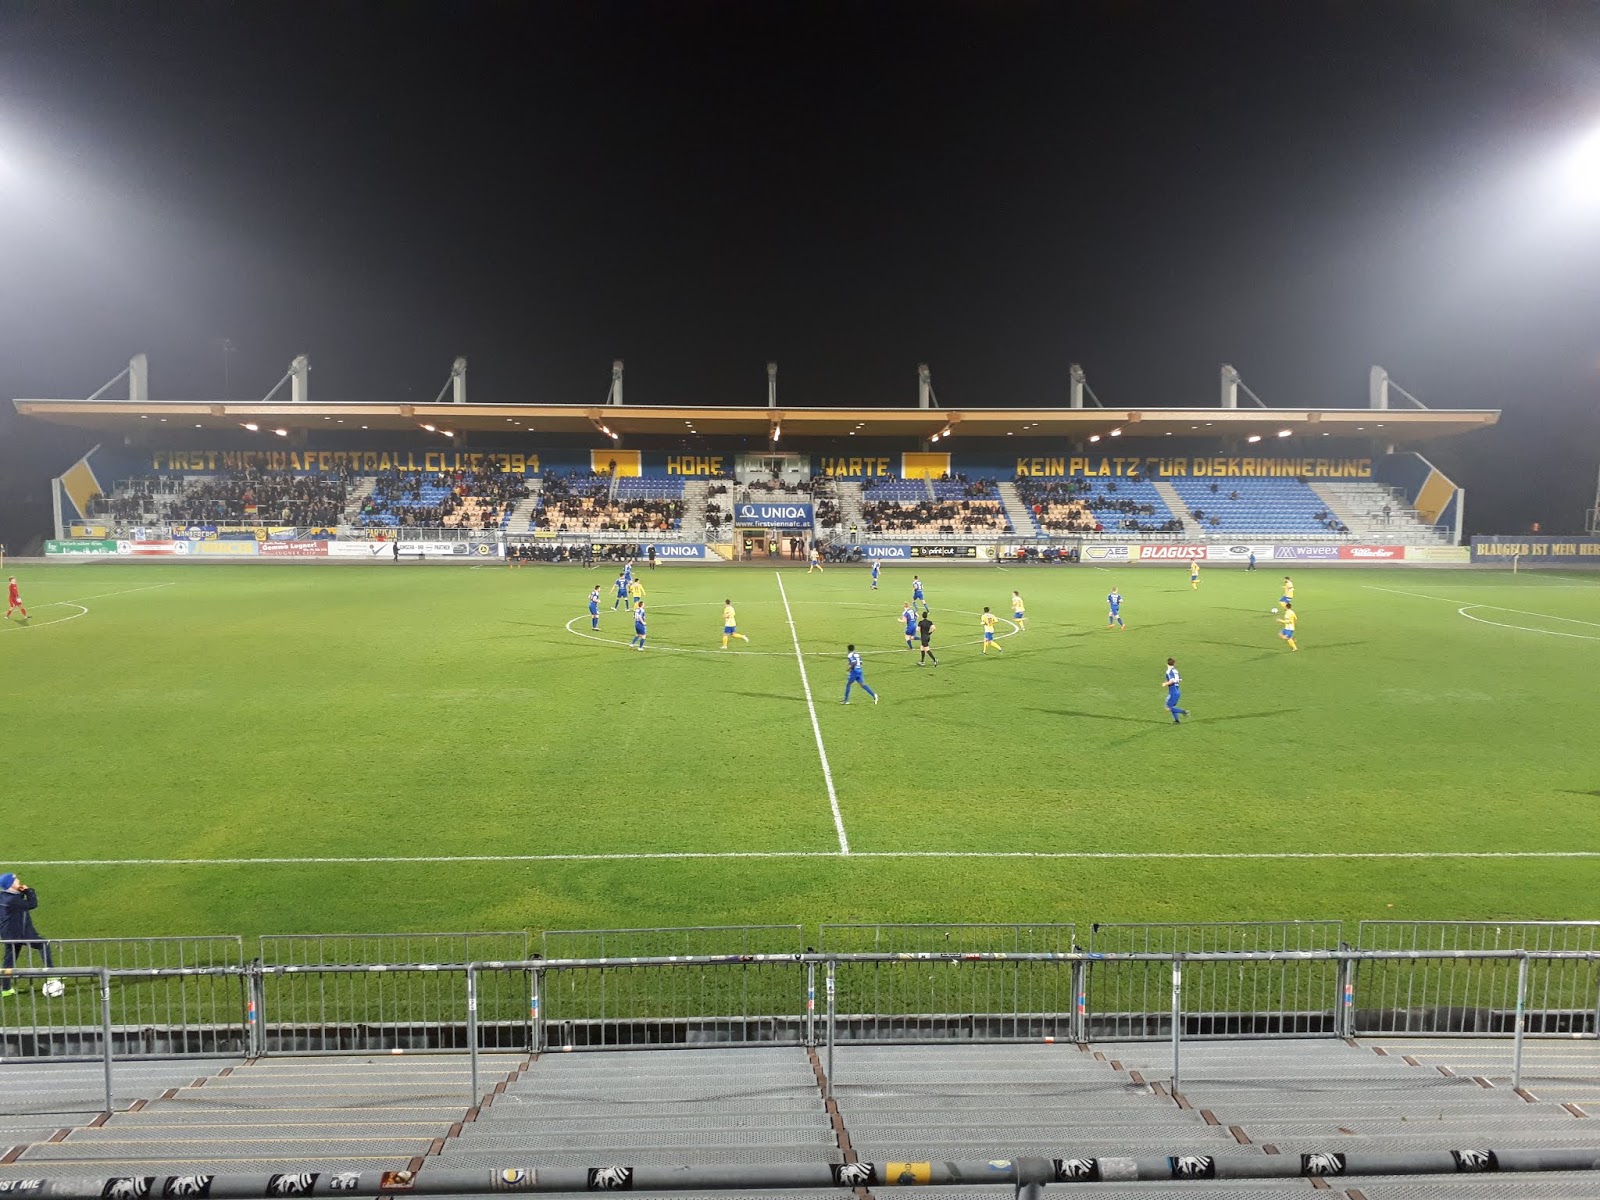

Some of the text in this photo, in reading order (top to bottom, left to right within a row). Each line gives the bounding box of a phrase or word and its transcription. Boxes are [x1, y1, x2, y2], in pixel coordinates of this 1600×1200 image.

[152, 450, 218, 470] FIRST
[667, 456, 724, 475] HOHE
[1016, 457, 1065, 477] KEIN
[1069, 457, 1140, 477] PLATZ
[1192, 457, 1372, 477] DISKRIMINIERUNG
[761, 507, 806, 519] UNIQA
[661, 546, 699, 556] UNIQA
[868, 547, 905, 557] UNIQA
[1140, 546, 1205, 559] BLAGUSS
[1297, 547, 1338, 555] waveex
[1531, 543, 1549, 556] IST
[19, 1179, 41, 1190] ME
